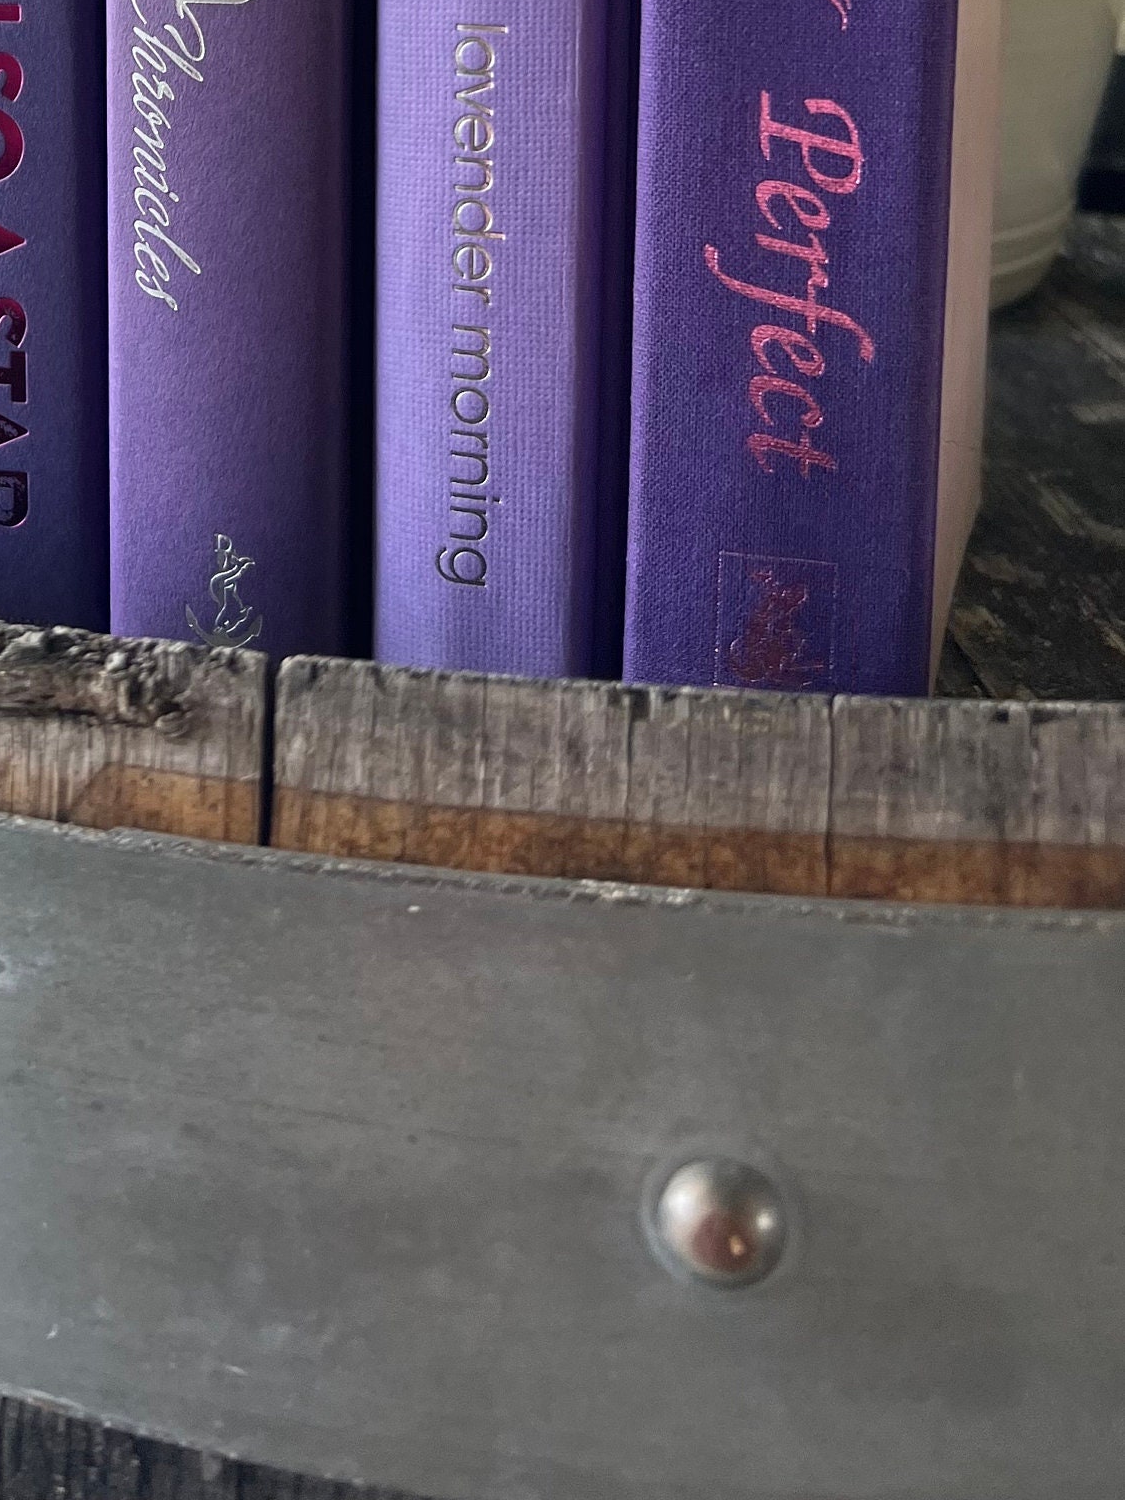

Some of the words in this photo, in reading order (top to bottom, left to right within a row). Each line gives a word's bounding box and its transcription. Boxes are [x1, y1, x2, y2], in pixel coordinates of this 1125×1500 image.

[452, 22, 509, 308] lavender
[703, 90, 875, 480] Perfect
[434, 323, 503, 589] morning
